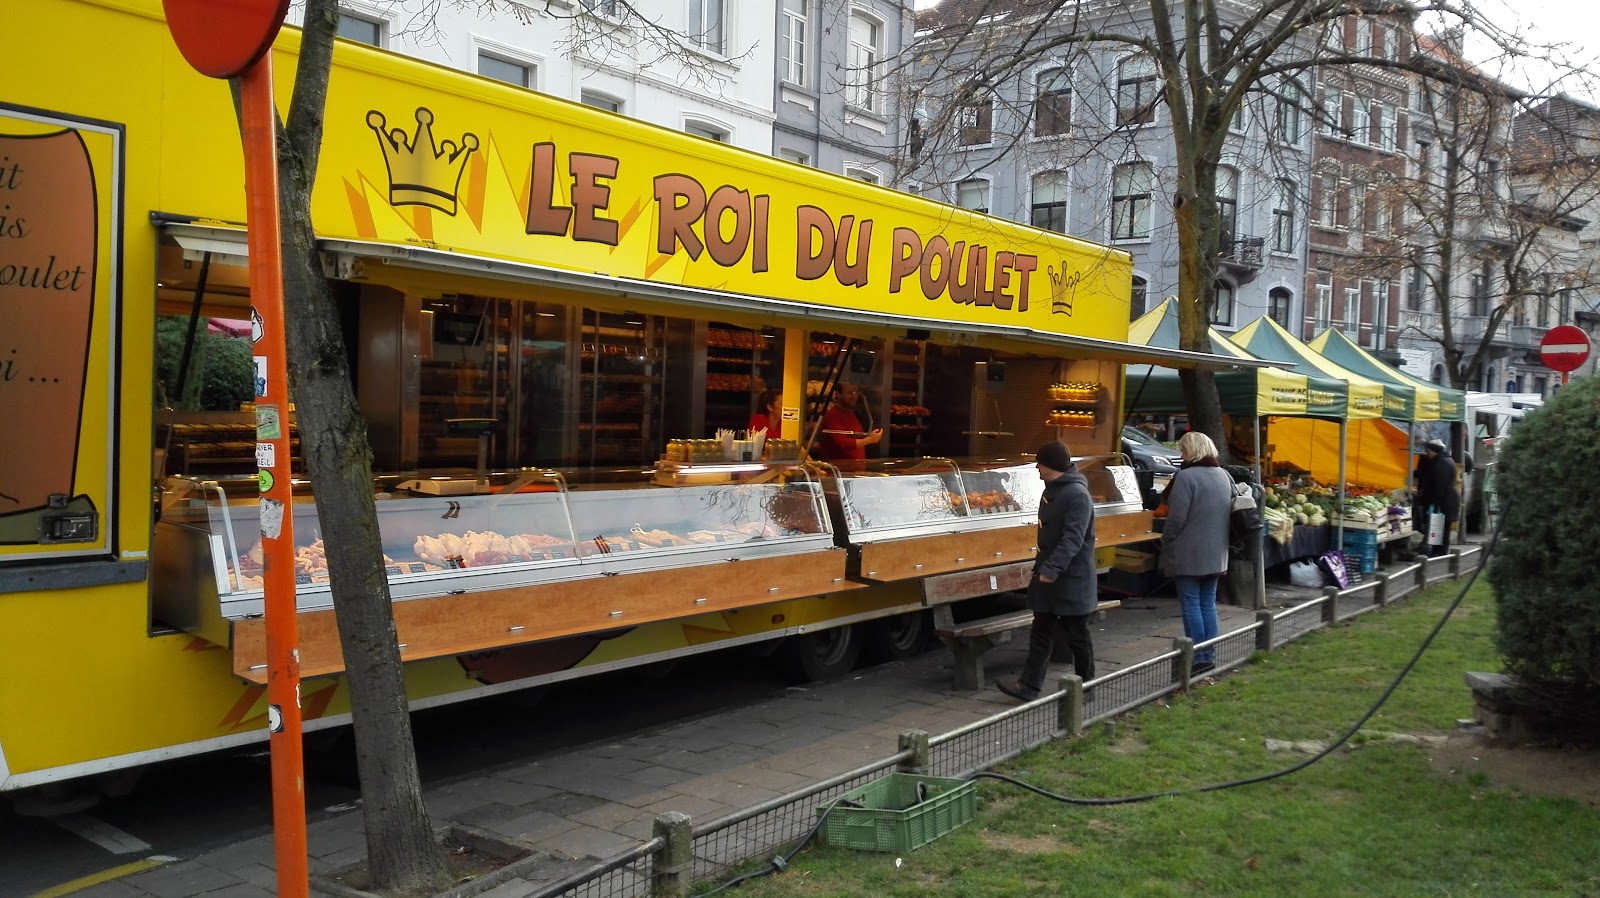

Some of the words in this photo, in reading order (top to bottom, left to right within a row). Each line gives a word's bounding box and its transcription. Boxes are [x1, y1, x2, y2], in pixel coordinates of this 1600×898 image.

[525, 141, 619, 246] LE
[653, 173, 770, 274] ROI
[796, 205, 873, 288] DU
[889, 227, 1037, 312] POULET
